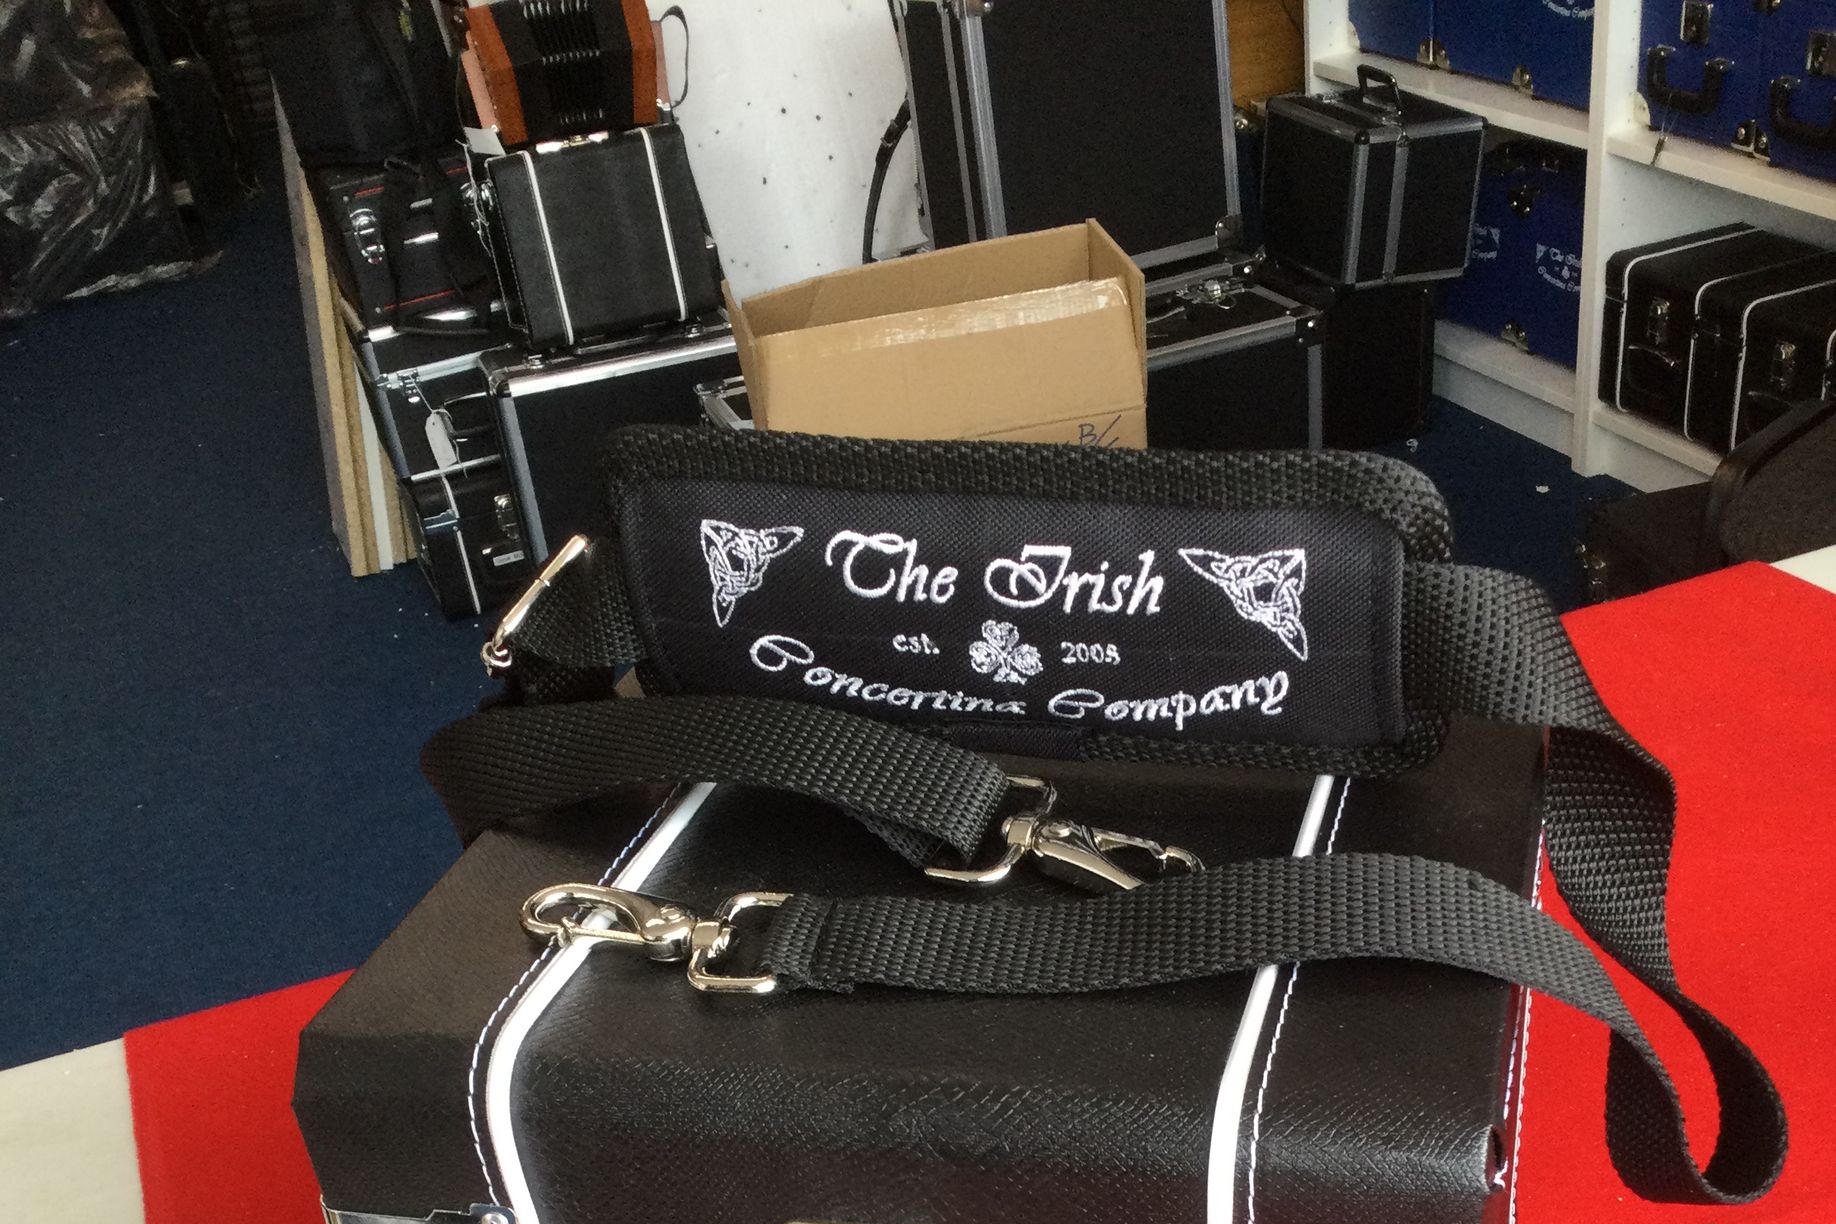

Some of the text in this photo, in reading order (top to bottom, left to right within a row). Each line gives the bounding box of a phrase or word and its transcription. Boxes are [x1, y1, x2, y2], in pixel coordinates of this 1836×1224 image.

[825, 530, 1164, 615] The Irish
[749, 635, 1289, 731] Concertina Company
[892, 633, 940, 655] est.
